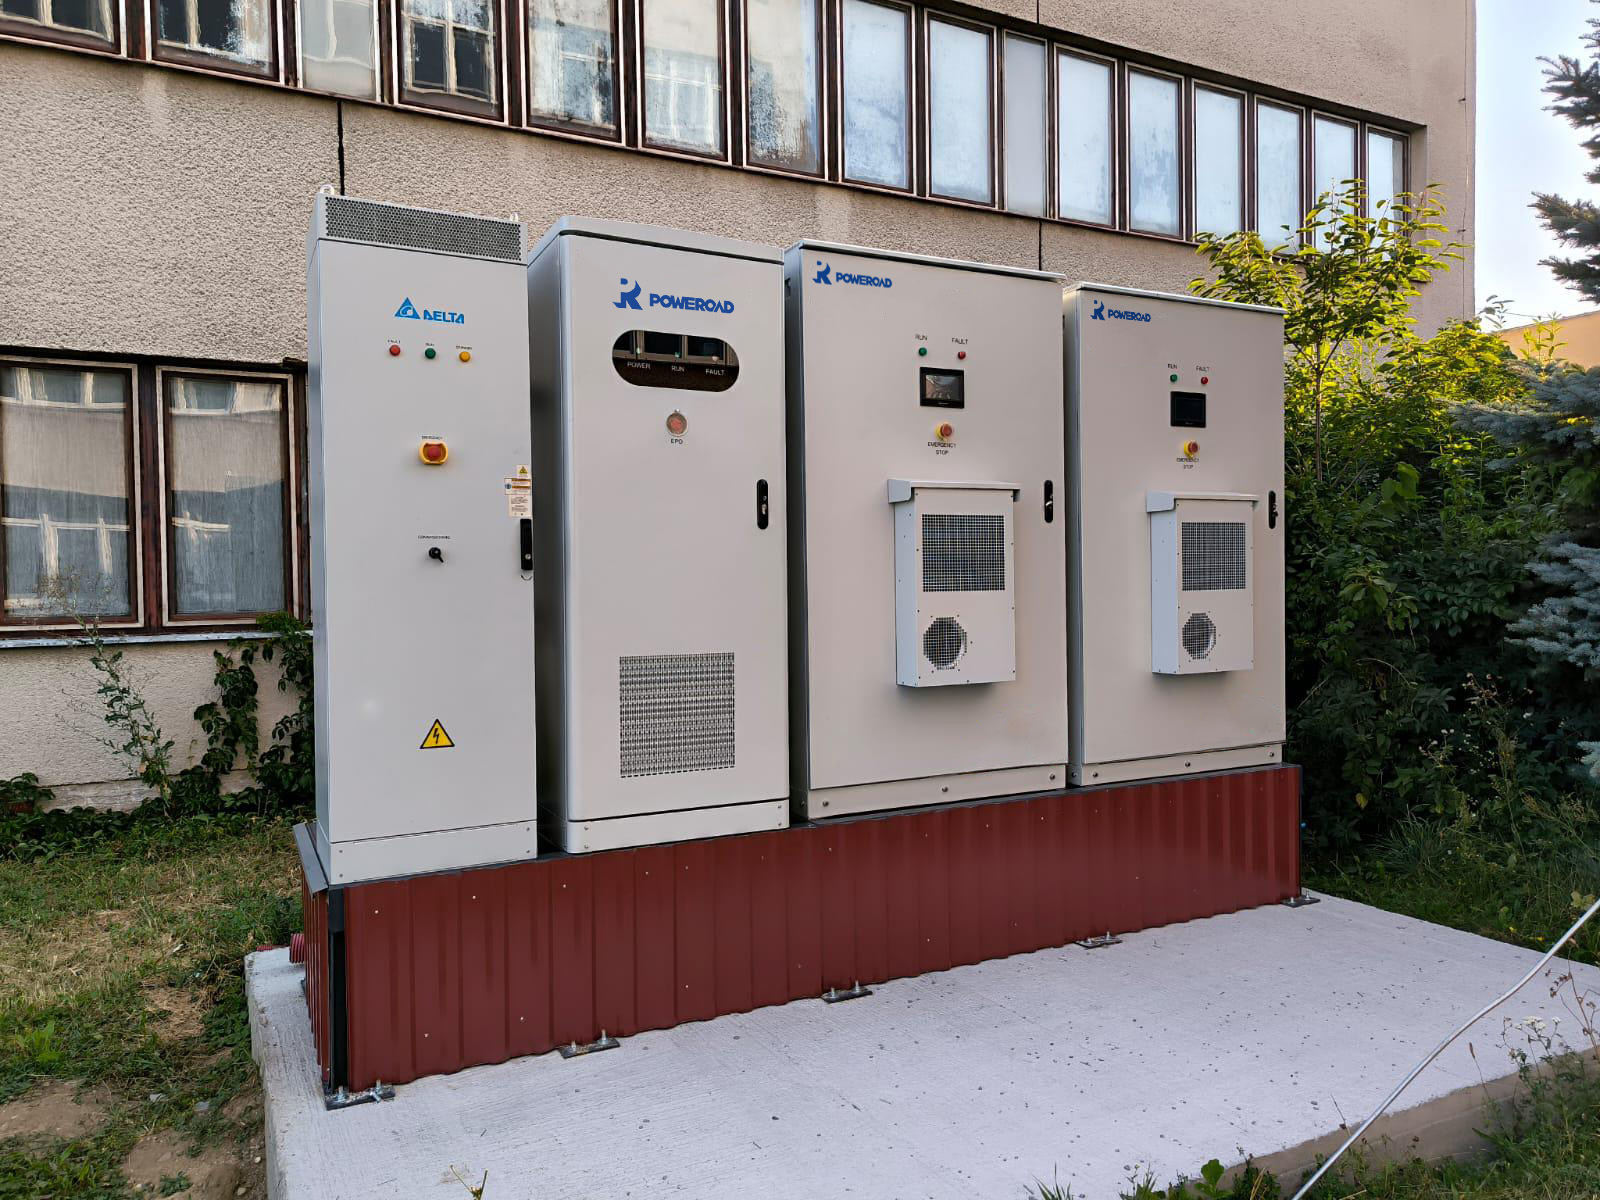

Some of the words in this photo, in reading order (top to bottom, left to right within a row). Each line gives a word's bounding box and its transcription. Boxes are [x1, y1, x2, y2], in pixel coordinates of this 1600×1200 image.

[835, 271, 893, 289] POWEROAD
[649, 293, 735, 314] POWEROAD
[423, 308, 465, 325] DELTA
[1107, 308, 1152, 323] POWEROAD
[951, 337, 969, 345] FAULT
[626, 361, 651, 370] POWER
[705, 368, 725, 376] FAULT
